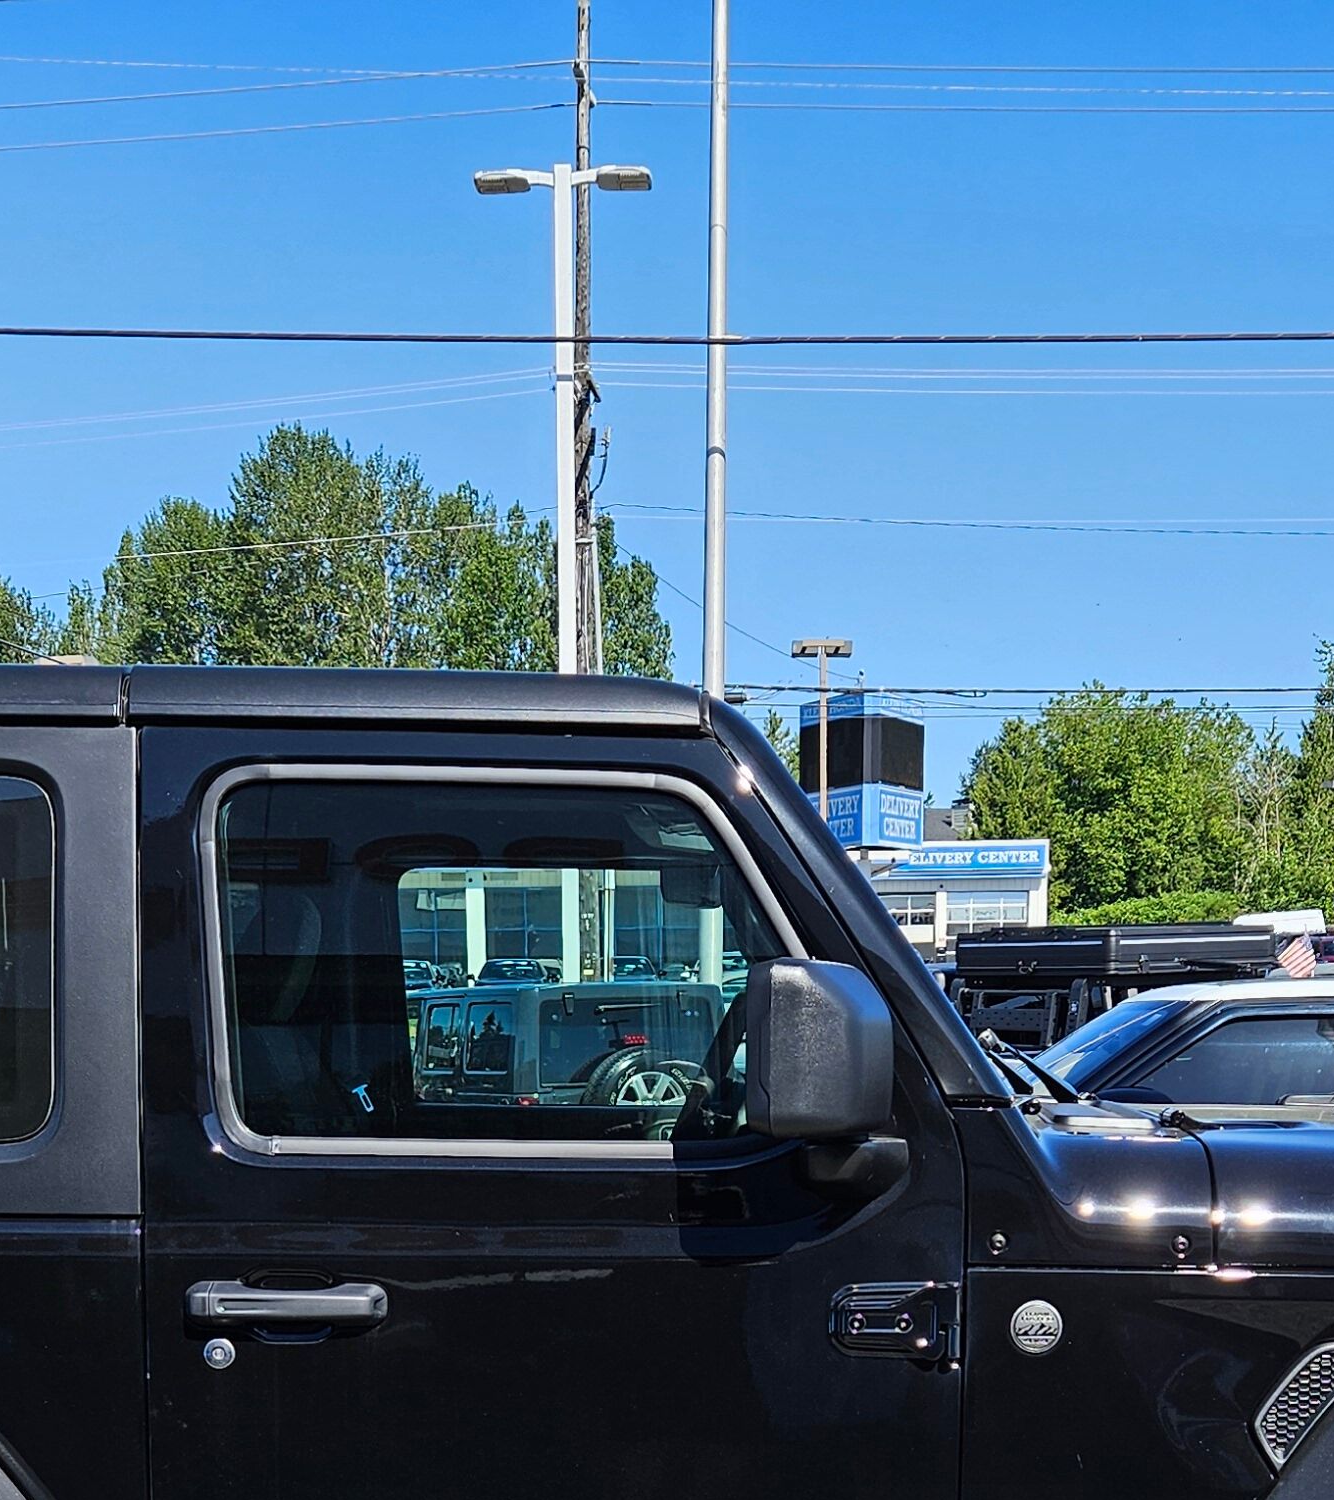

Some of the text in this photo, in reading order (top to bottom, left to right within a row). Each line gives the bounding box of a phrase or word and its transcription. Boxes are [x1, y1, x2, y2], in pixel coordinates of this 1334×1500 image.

[880, 794, 920, 818] DELIVERY
[883, 817, 916, 839] CENTER
[977, 850, 1040, 864] CENTER
